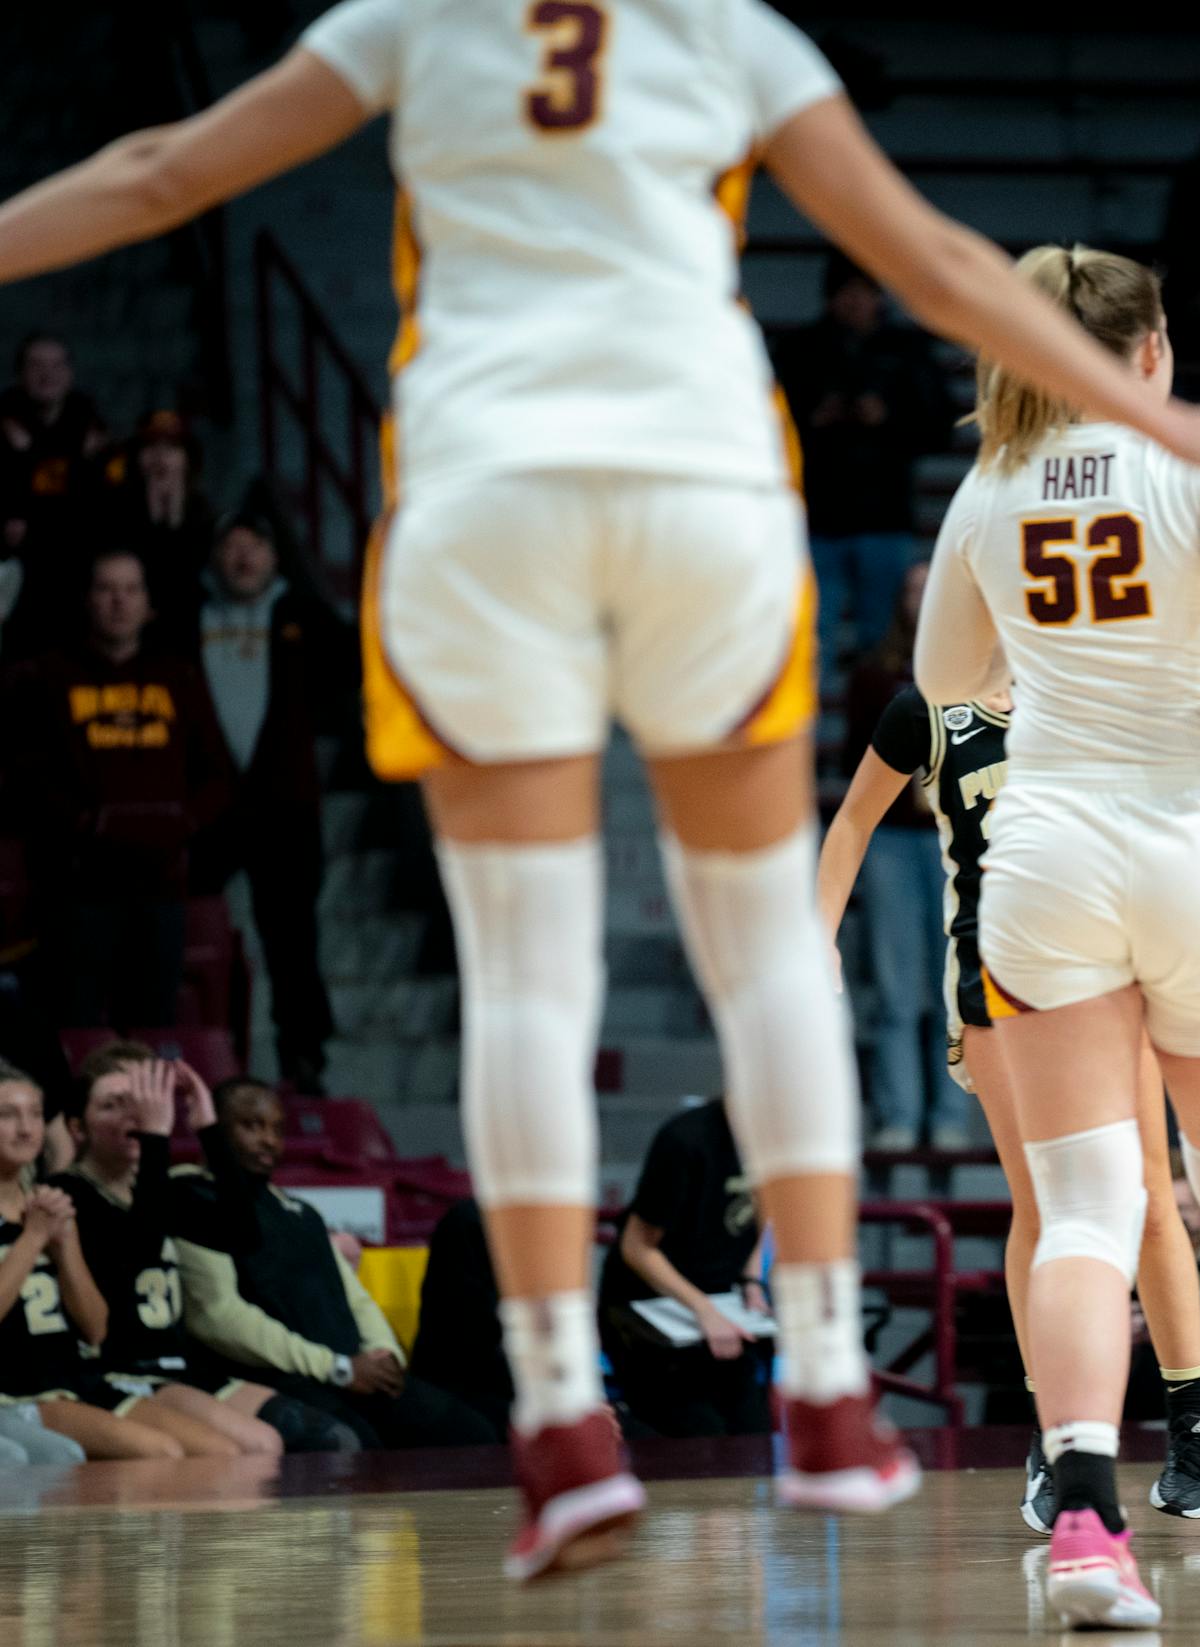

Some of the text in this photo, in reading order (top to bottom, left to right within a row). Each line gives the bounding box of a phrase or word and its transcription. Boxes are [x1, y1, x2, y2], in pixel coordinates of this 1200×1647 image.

[526, 0, 606, 132] 3
[1041, 452, 1116, 500] HART
[1020, 511, 1154, 627] 52
[19, 1271, 69, 1335] 2
